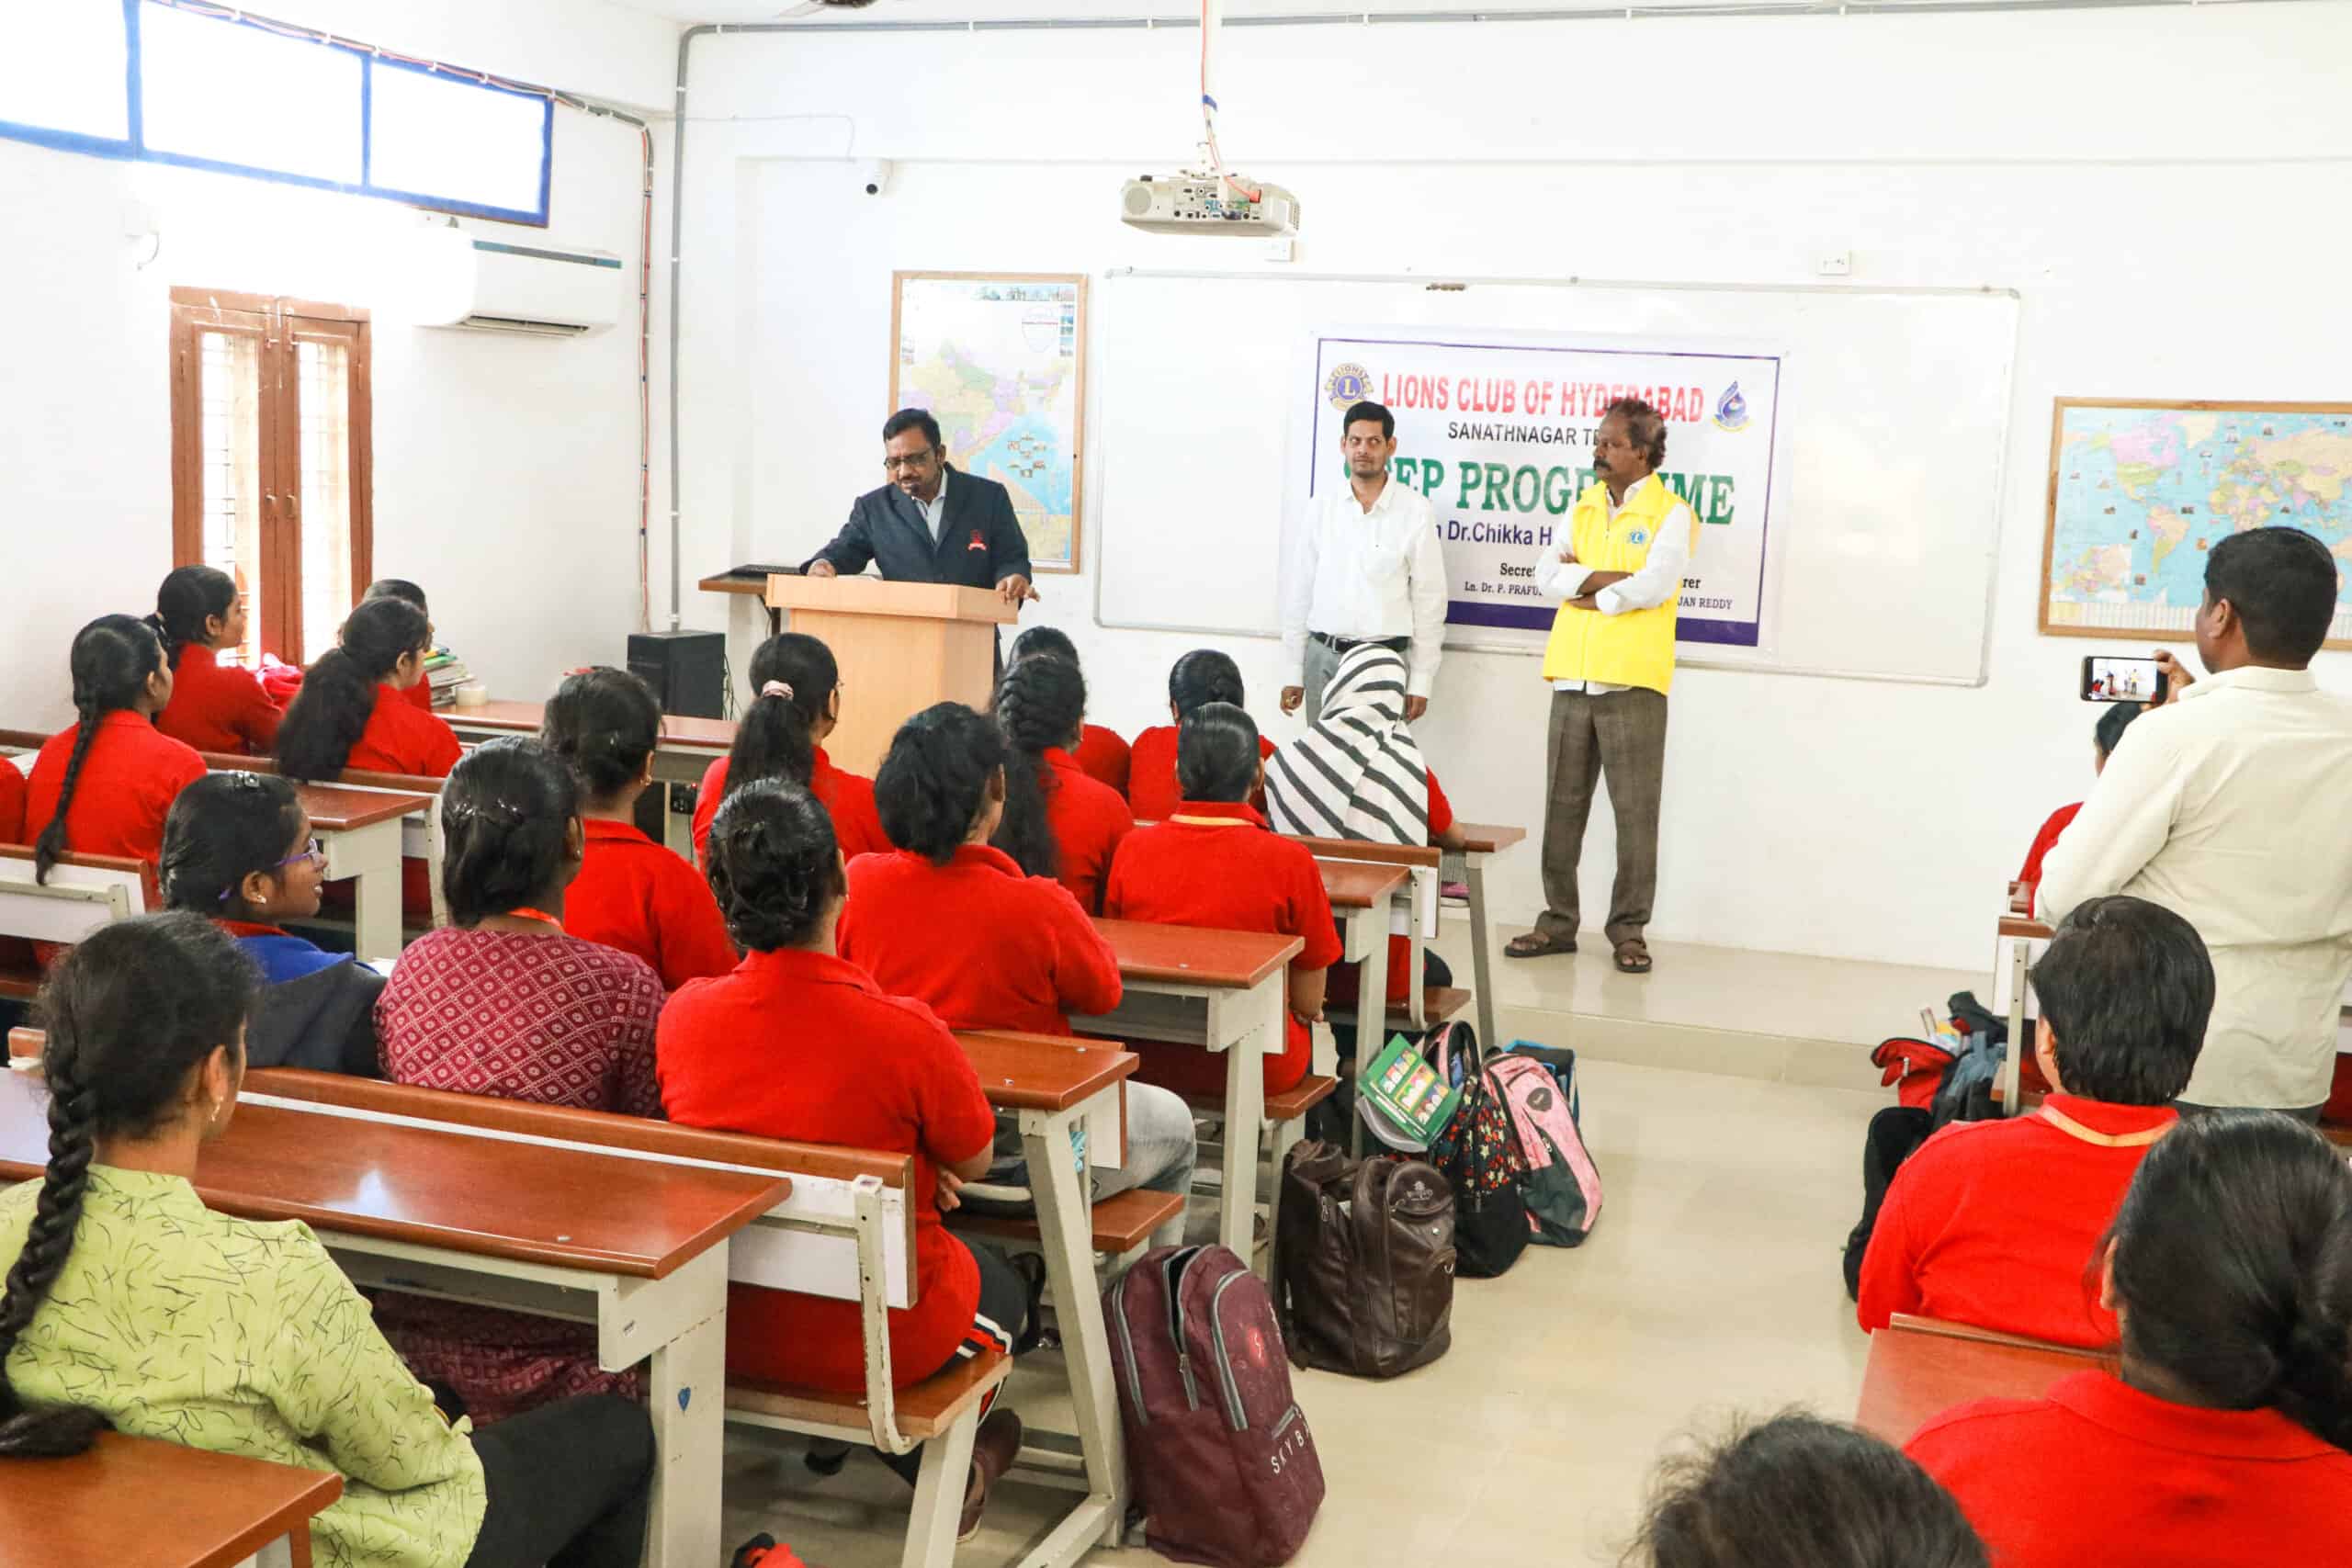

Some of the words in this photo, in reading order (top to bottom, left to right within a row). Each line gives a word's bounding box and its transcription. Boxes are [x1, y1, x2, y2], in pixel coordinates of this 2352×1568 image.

[1383, 374, 1450, 411] LIONS
[1457, 377, 1516, 414] CLUB
[1524, 380, 1554, 415] OF
[1448, 421, 1577, 446] SANATHNAGAR
[1481, 582, 1495, 594] Dr.
[1699, 598, 1733, 610] REDDY
